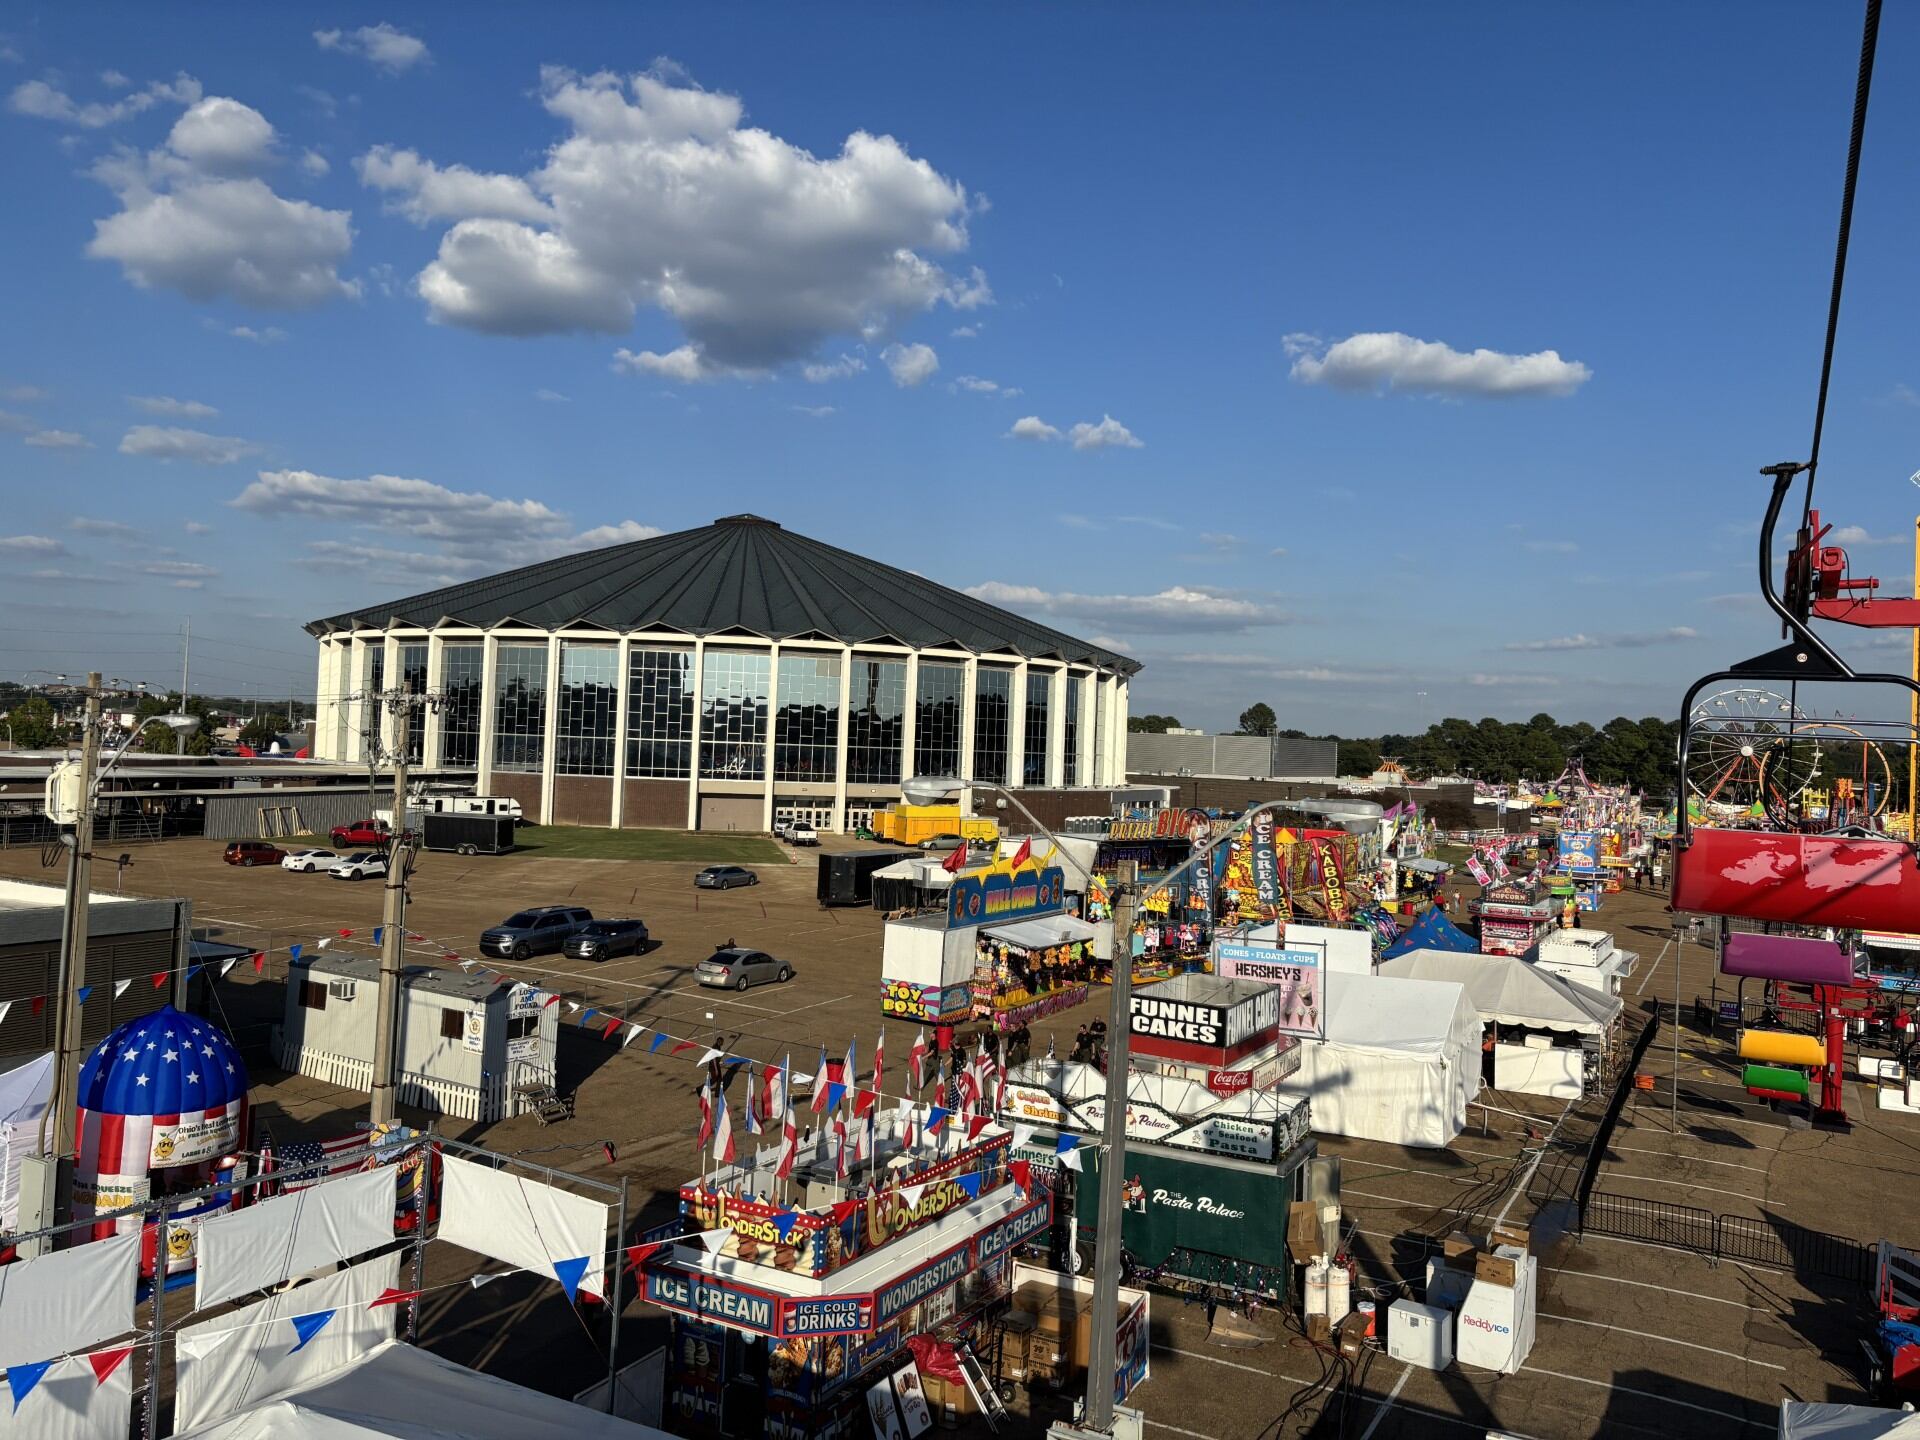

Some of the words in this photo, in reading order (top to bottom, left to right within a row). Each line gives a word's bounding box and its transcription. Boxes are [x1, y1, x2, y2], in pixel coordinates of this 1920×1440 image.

[1109, 821, 1153, 840] PRIZES
[1155, 808, 1190, 838] BIG
[1256, 815, 1270, 844] ICE
[1257, 850, 1274, 900] CREAM
[1319, 845, 1343, 909] KABOBS
[1223, 948, 1249, 957] CONES
[1256, 951, 1286, 961] FLOATS
[1293, 955, 1315, 964] CUPS
[1236, 963, 1301, 981] HERSHEY'S
[886, 984, 923, 1001] TOY
[515, 1002, 538, 1010] FOUND
[884, 1000, 925, 1016] BOX!
[1130, 998, 1222, 1026] FUNNEL
[1227, 999, 1254, 1046] FUNNEL
[1255, 989, 1279, 1031] CAKES
[1132, 1016, 1217, 1043] CAKES
[1213, 1072, 1248, 1086] Coca-Cola
[1017, 1090, 1050, 1104] Cajun
[1023, 1105, 1068, 1122] Shrimp
[1086, 1106, 1106, 1119] Pas
[178, 1123, 200, 1134] Ohio's
[1139, 1114, 1171, 1130] Palace
[1213, 1120, 1254, 1133] Chicken
[1203, 1129, 1214, 1137] or
[1218, 1130, 1257, 1143] Seafood
[1209, 1138, 1258, 1154] Pasta
[1010, 1147, 1055, 1165] Dinners
[1153, 1188, 1193, 1210] Pasta
[1197, 1197, 1245, 1219] Palace
[1170, 1191, 1182, 1199] THE
[979, 1231, 1001, 1260] ICE
[1005, 1205, 1047, 1243] CREAM
[882, 1251, 965, 1315] WONDERSTICK
[655, 1275, 689, 1303] ICE
[694, 1286, 769, 1327] CREAM
[799, 1304, 820, 1314] ICE
[824, 1302, 857, 1312] COLD
[799, 1311, 857, 1330] DRINKS
